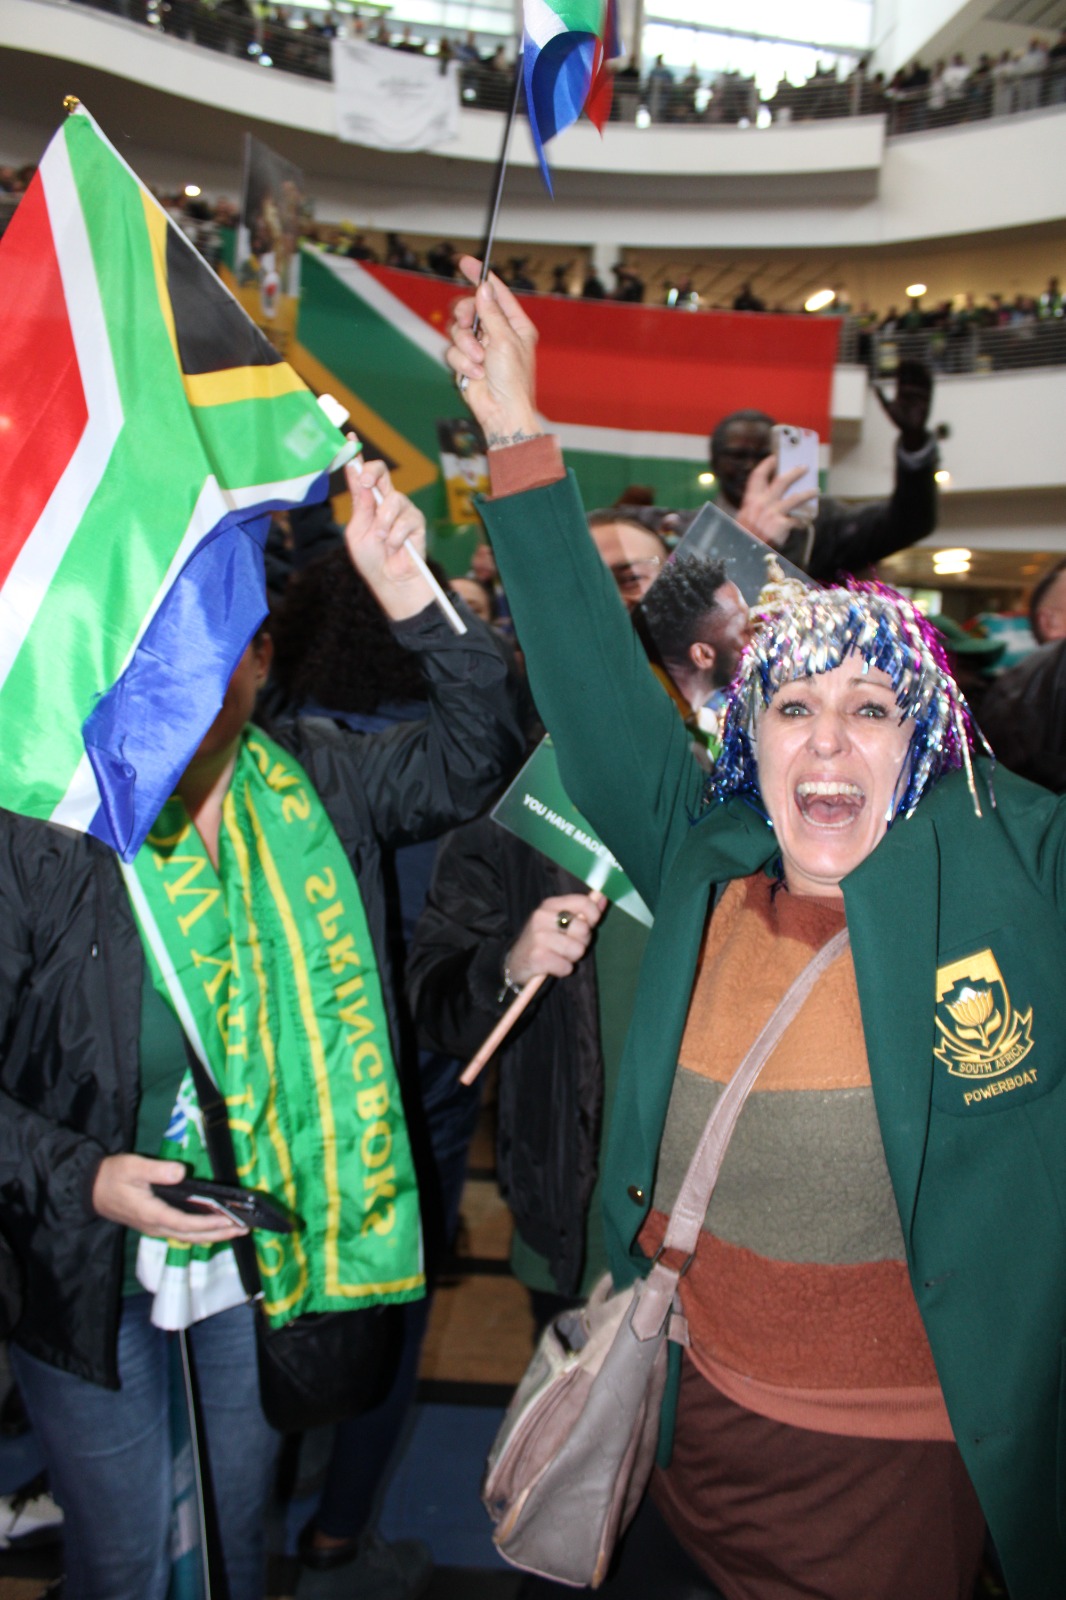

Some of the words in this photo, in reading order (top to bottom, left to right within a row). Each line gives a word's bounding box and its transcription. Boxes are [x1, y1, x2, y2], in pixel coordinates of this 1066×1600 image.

[522, 793, 548, 817] YOU
[544, 809, 576, 837] HAVE
[959, 1061, 992, 1074] SOUTH
[995, 1043, 1026, 1070] AFRICA
[963, 1068, 1038, 1106] POWERBOAT
